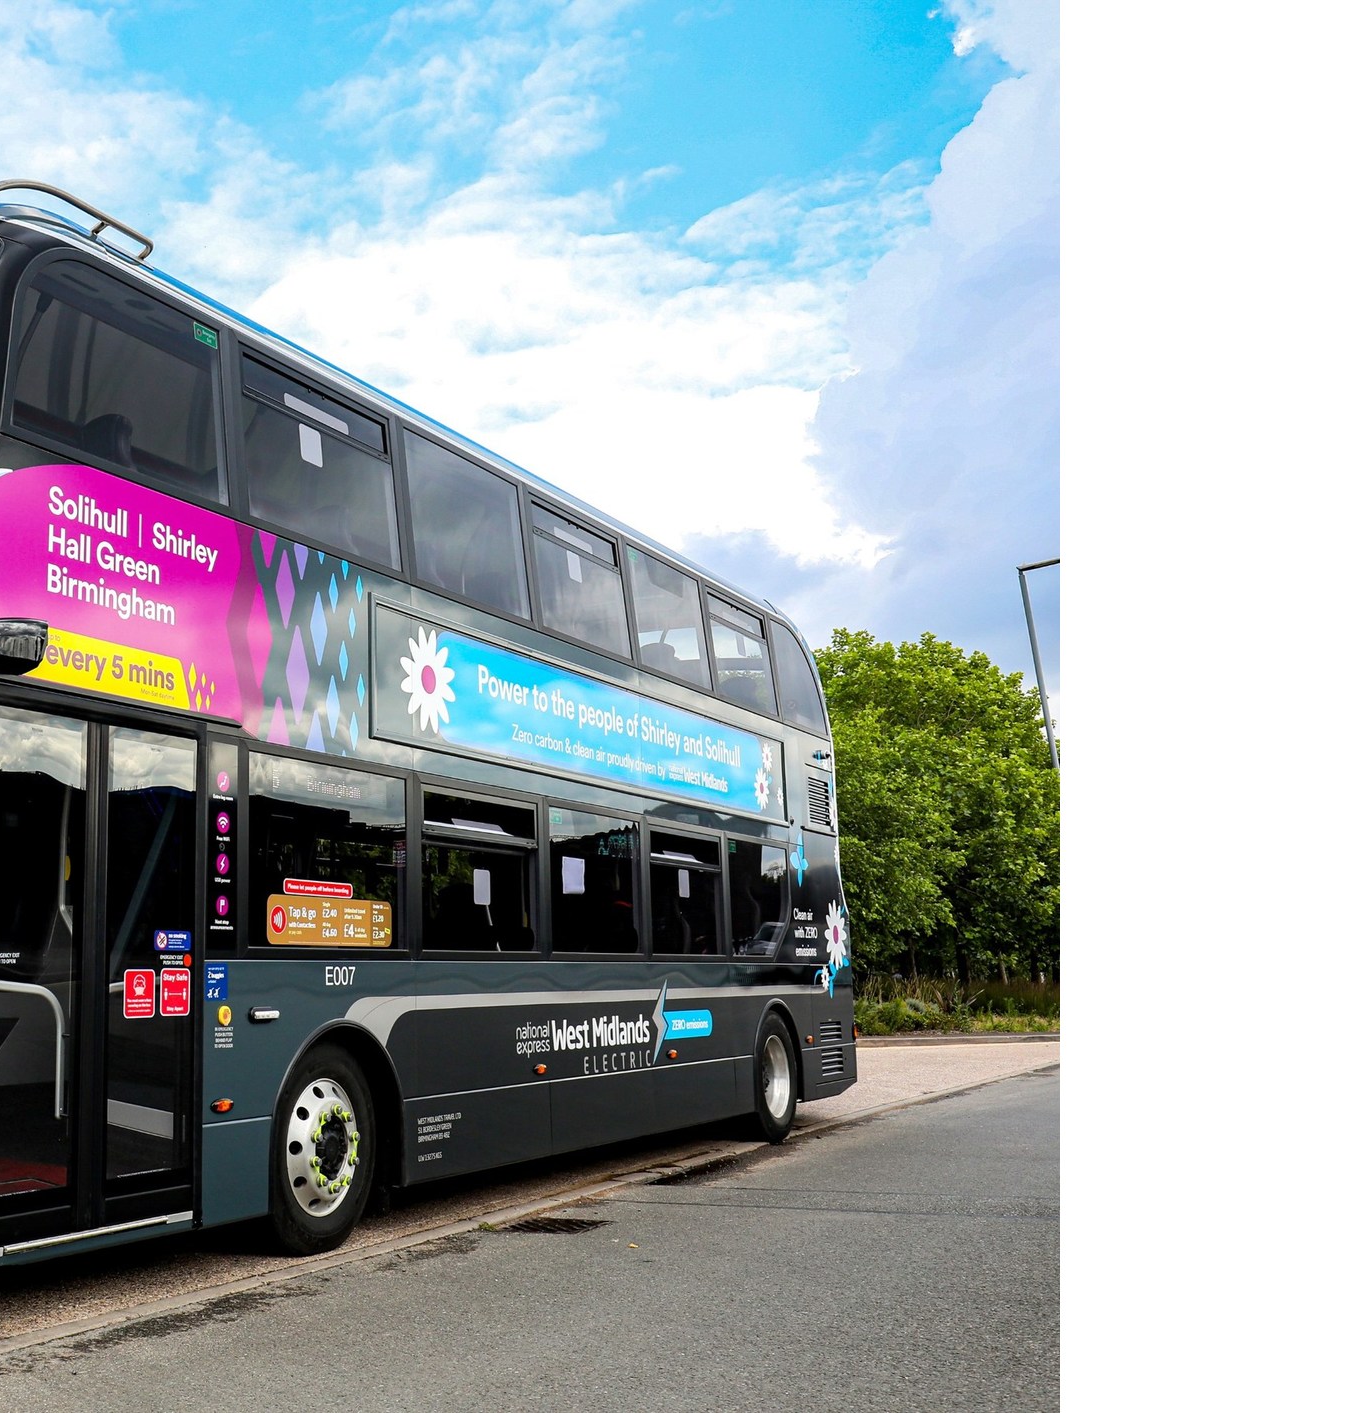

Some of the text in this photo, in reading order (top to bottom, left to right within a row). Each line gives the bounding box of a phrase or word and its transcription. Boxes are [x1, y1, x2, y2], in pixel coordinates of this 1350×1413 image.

[48, 486, 218, 572] Solihull Shirley
[48, 524, 160, 585] Hall Green
[46, 563, 176, 626] Birmingham
[46, 645, 175, 691] every 5 mins
[477, 664, 741, 768] Power to the people of Shirley and Solihull
[512, 723, 666, 781] Zero carbon & clean air proudly driven by
[307, 775, 361, 799] Birmingham
[683, 767, 728, 793] West Midlands
[289, 906, 317, 920] Tap & go
[322, 908, 338, 918] £2.40
[793, 907, 807, 920] Clean
[343, 923, 355, 938] £4
[794, 926, 818, 938] with ZERO
[795, 944, 817, 957] emissions
[163, 973, 188, 982] Stay Safe
[325, 966, 356, 986] E007
[515, 1021, 550, 1040] national
[551, 1014, 650, 1051] West Midlands
[671, 1017, 709, 1031] ZERO emissions
[516, 1038, 550, 1058] express
[583, 1050, 651, 1075] ELECTRIC
